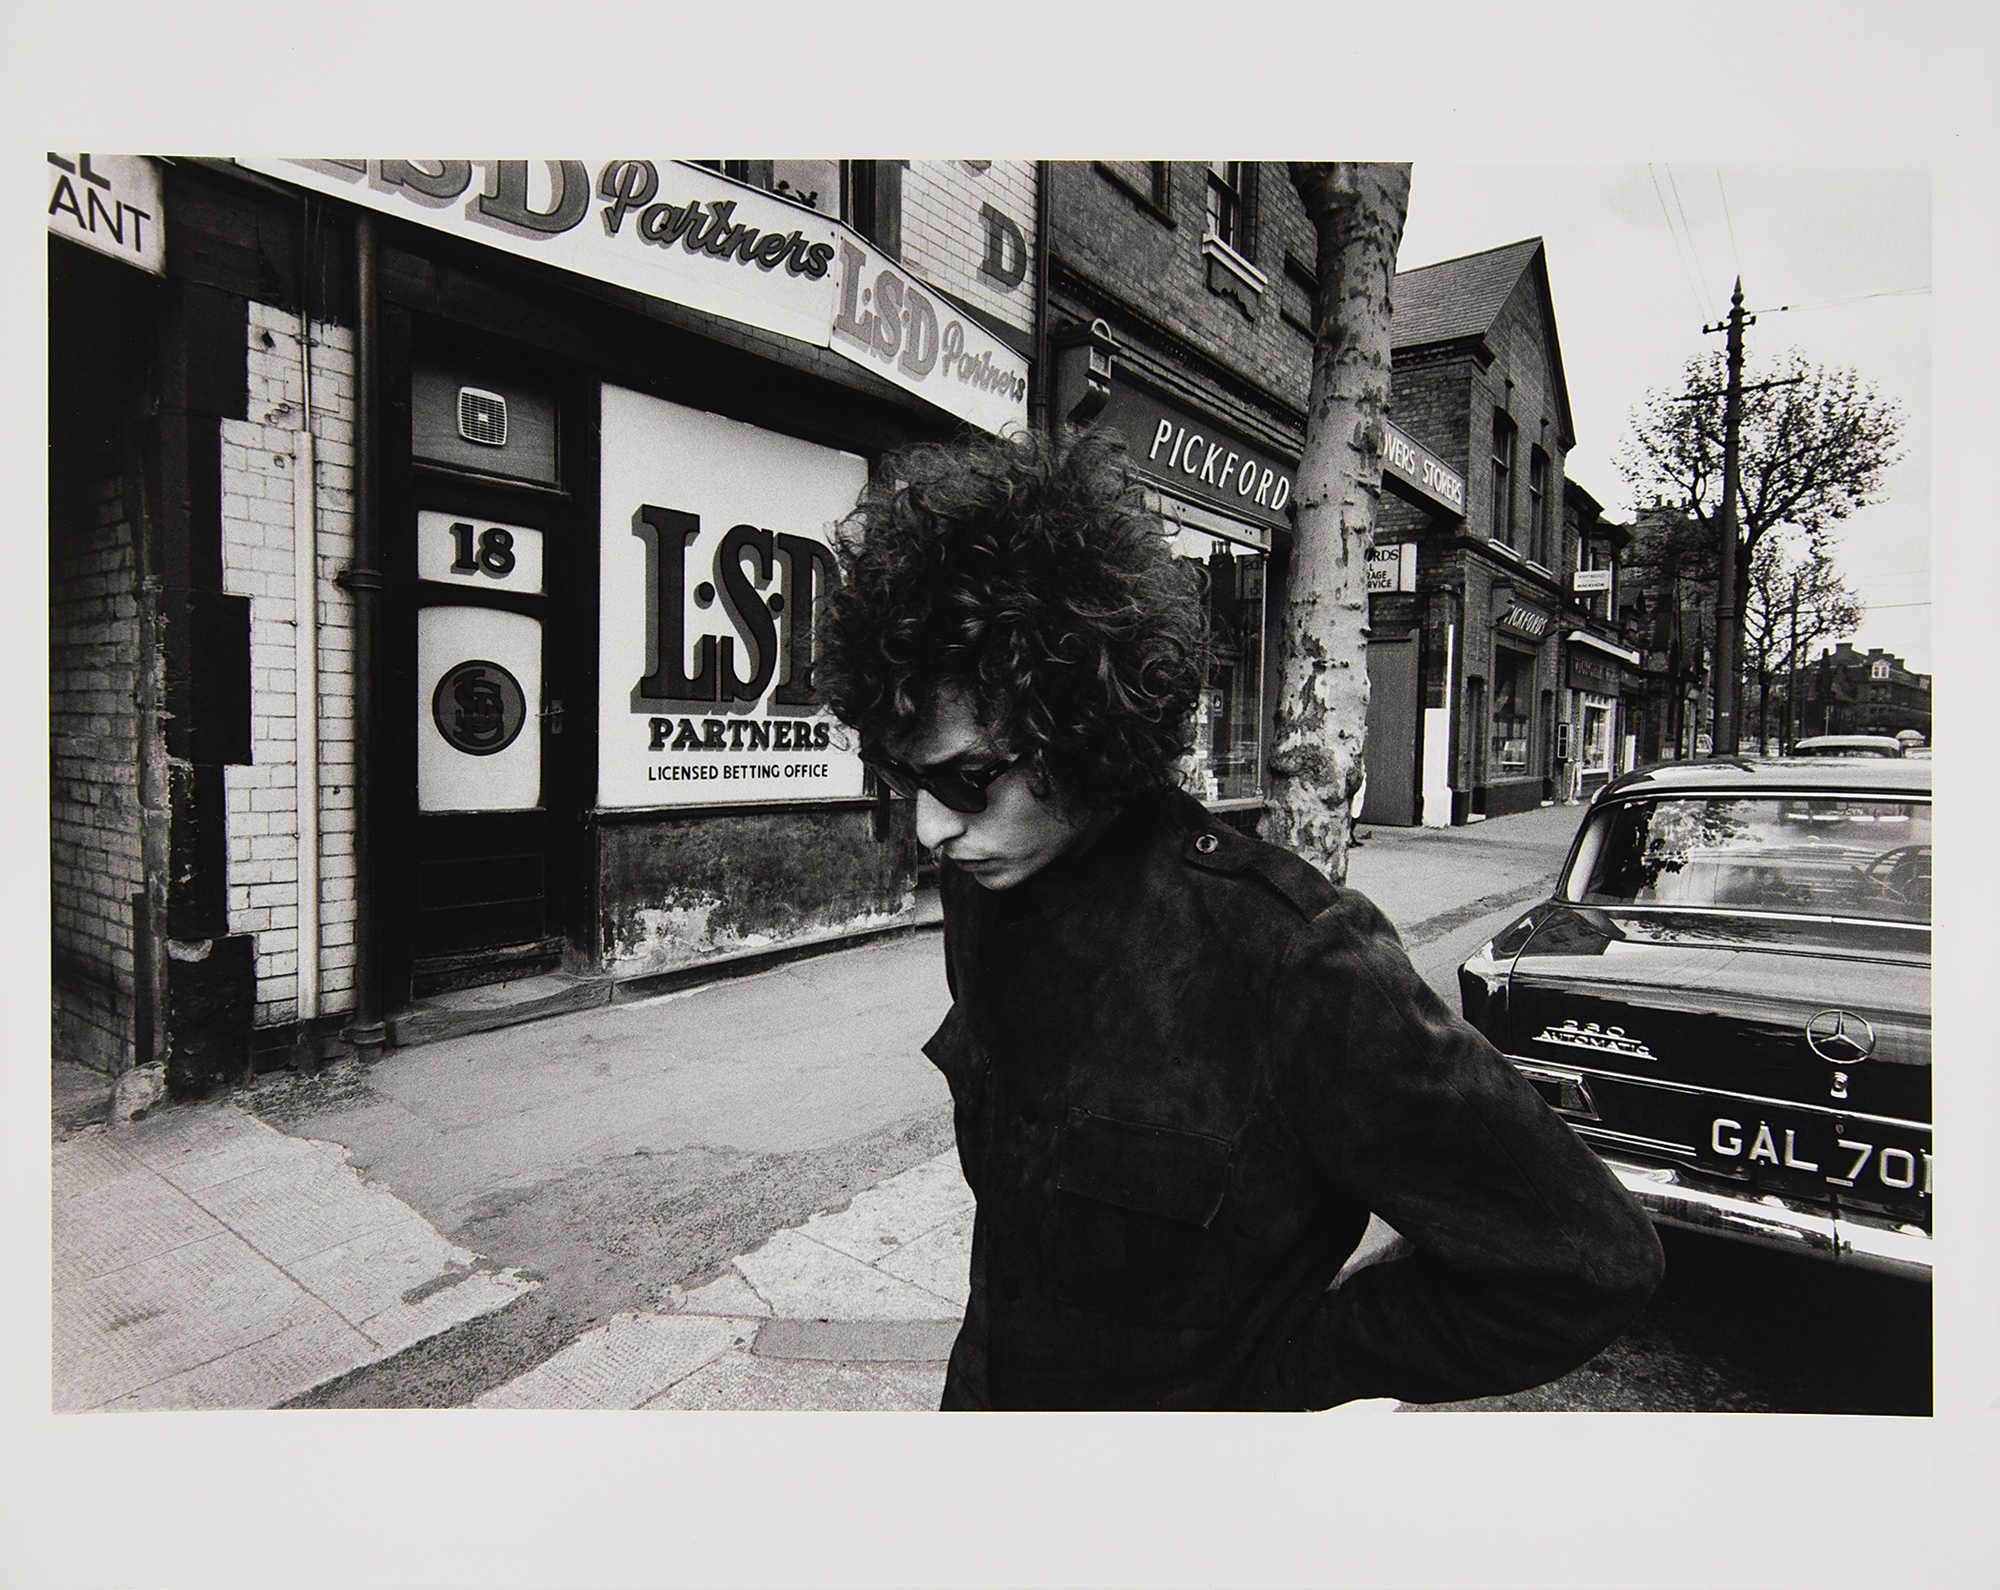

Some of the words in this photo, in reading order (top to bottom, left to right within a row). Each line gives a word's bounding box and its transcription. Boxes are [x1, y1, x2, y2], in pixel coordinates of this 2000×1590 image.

[48, 174, 151, 253] ANT
[595, 159, 836, 282] Partners
[976, 201, 1027, 294] D
[942, 320, 1026, 403] Partners
[1149, 418, 1291, 512] PICKFORD
[1422, 459, 1462, 505] STORERS
[449, 521, 517, 579] 18
[648, 717, 830, 751] PARTNERS
[648, 765, 719, 782] LICENSED
[723, 764, 780, 780] BETTING
[784, 763, 829, 778] OFFICE
[1539, 1030, 1651, 1056] AUTOMATIC
[1711, 1118, 1819, 1173] GAL
